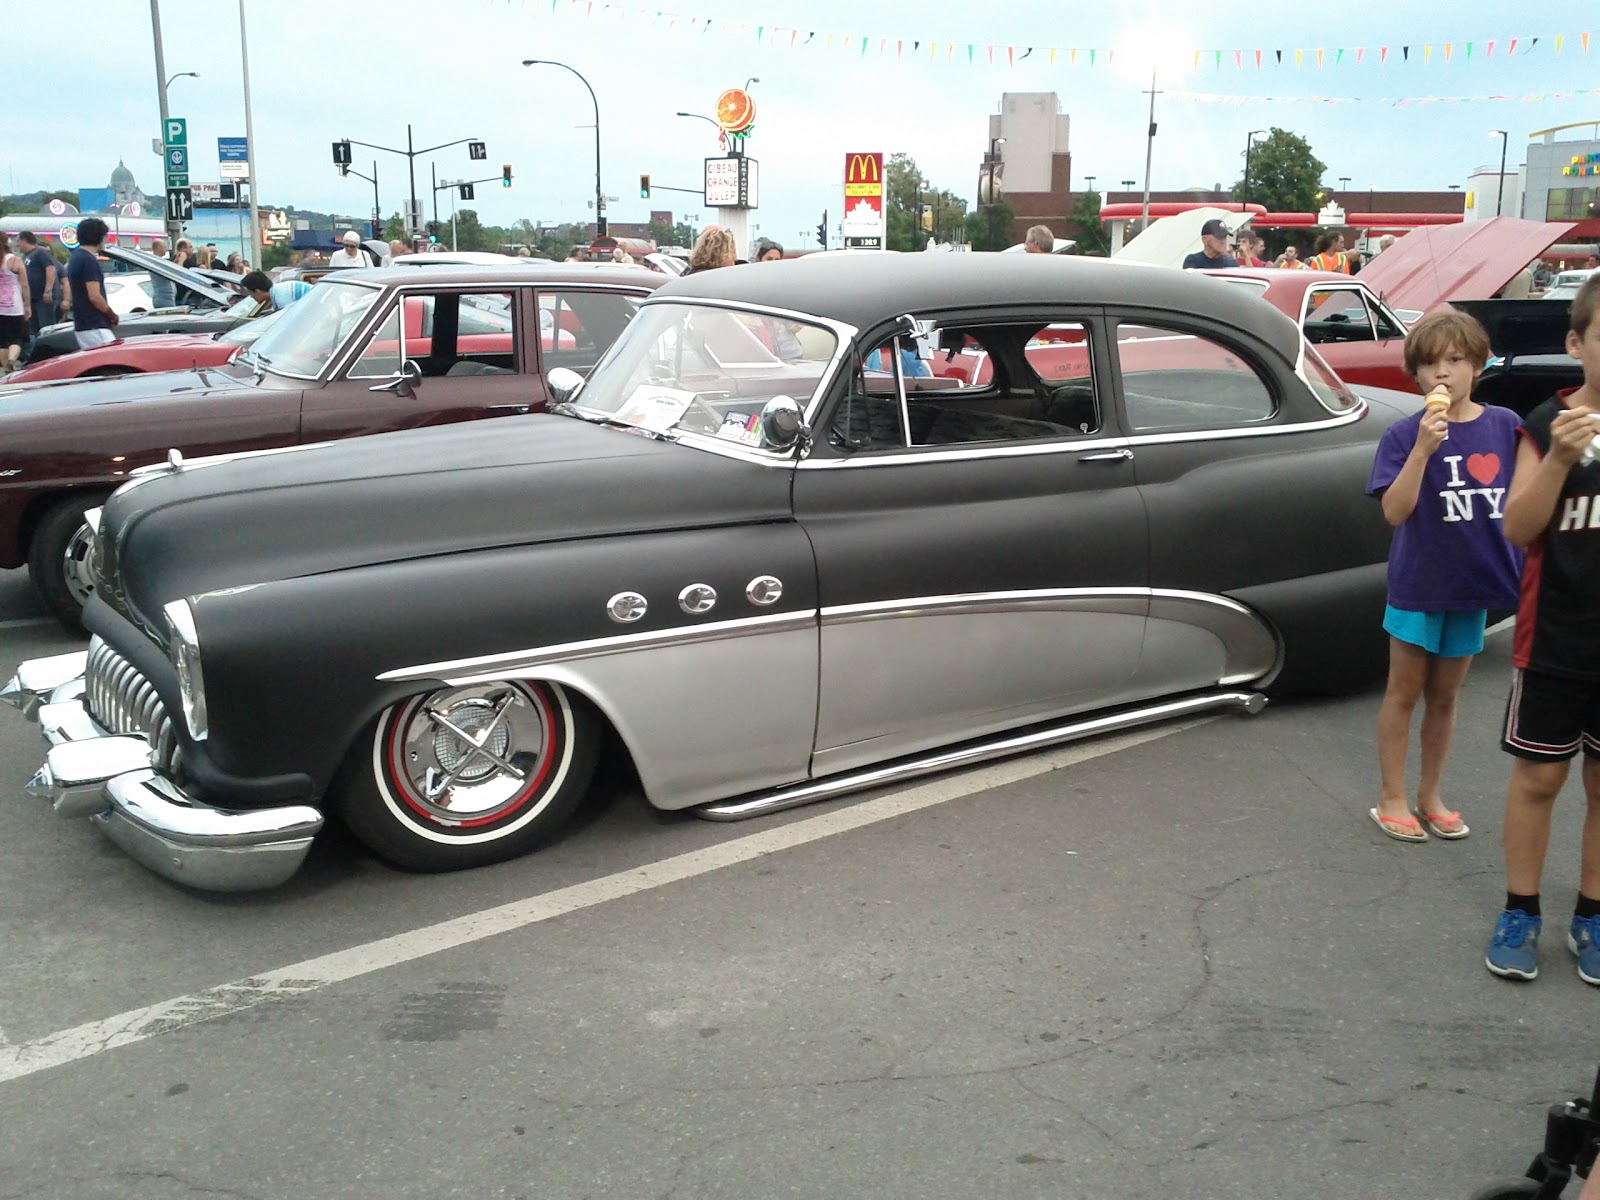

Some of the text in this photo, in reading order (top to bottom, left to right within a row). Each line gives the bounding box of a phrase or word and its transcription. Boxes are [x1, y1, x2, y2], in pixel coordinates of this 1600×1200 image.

[167, 122, 182, 142] P
[1571, 153, 1600, 165] PARC
[707, 177, 738, 187] ORANGE
[1443, 455, 1466, 487] I
[1439, 487, 1506, 522] NY
